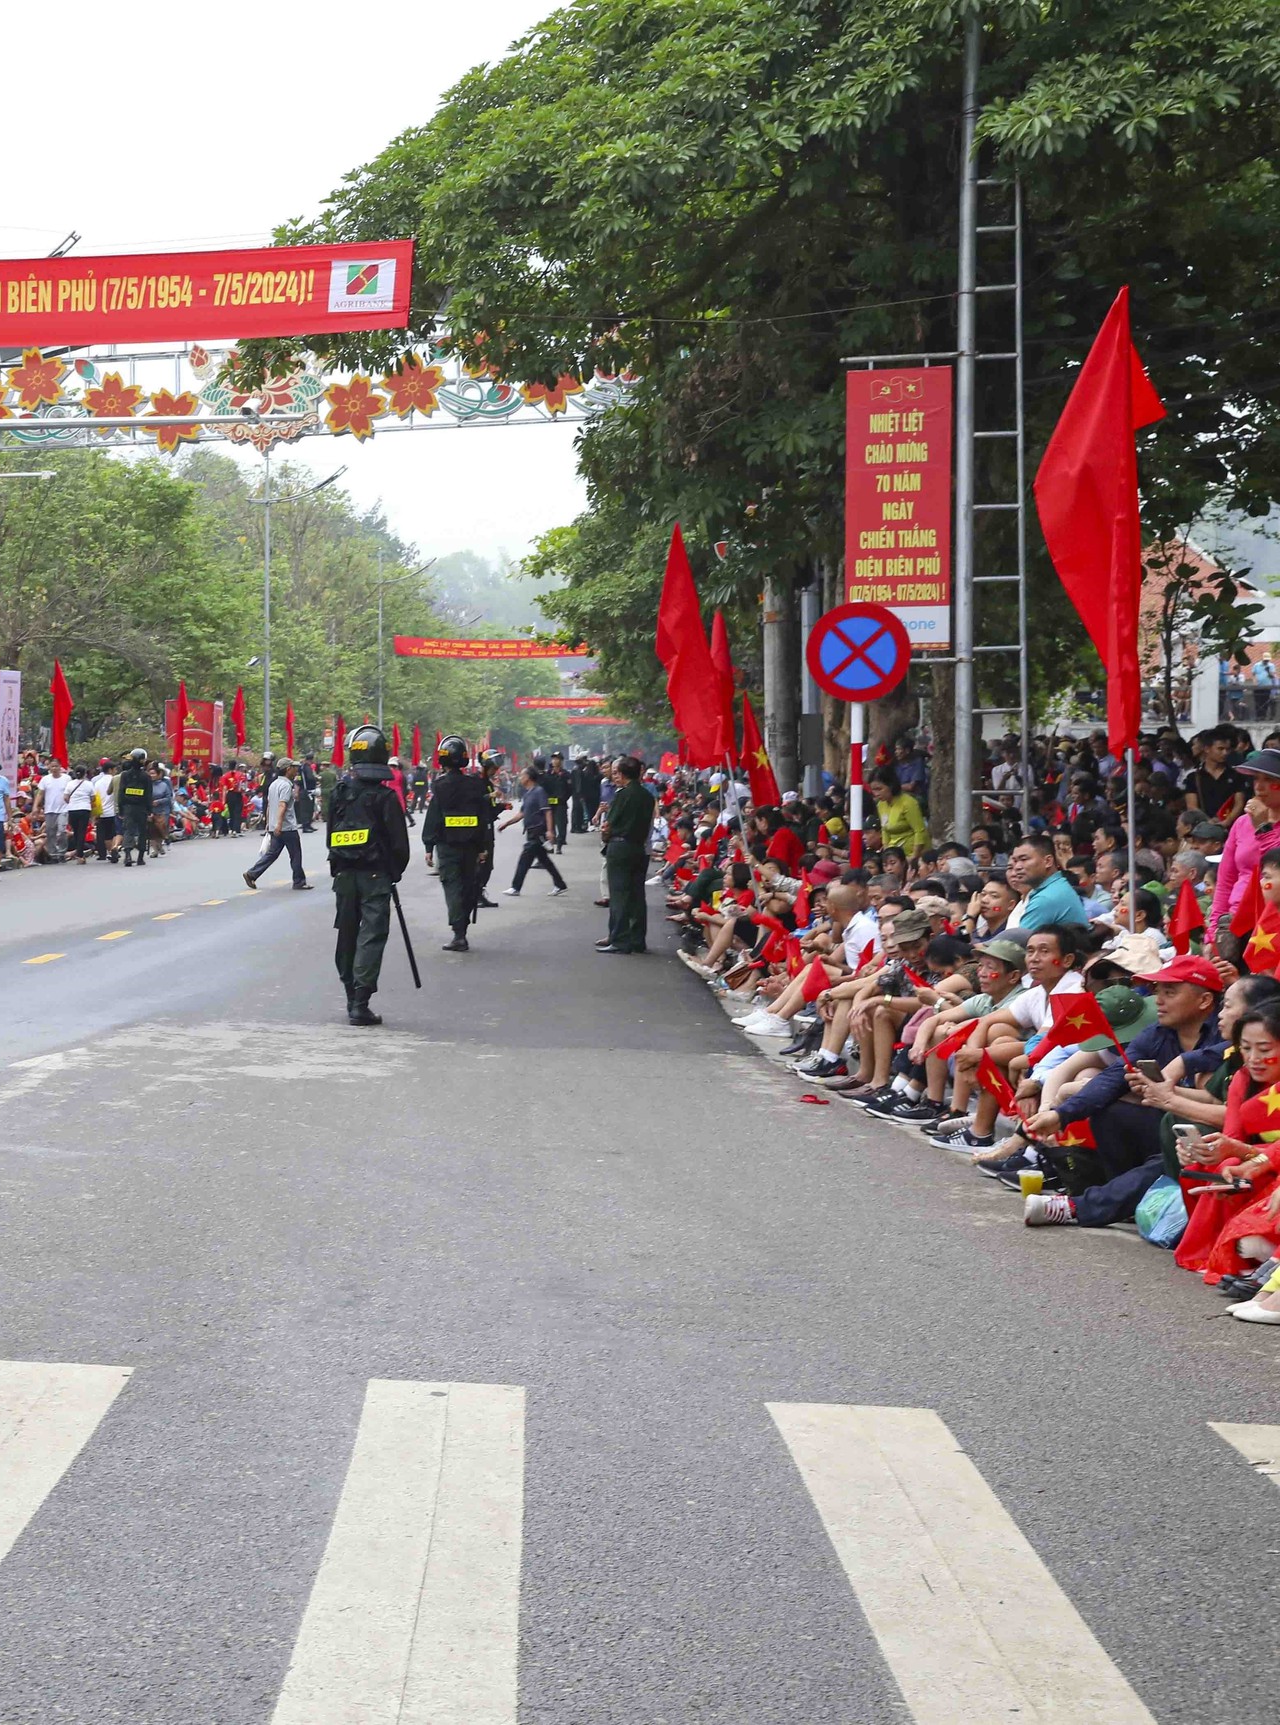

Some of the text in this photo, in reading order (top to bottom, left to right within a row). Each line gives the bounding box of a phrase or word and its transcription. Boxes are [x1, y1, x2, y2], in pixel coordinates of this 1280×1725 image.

[7, 273, 52, 313] BIÊN
[57, 270, 97, 312] PHỦ
[101, 275, 193, 314] (7/5/1954
[333, 299, 388, 308] AGRIBANK
[869, 408, 925, 437] NHIỆT LIỆT
[865, 439, 928, 464] CHÀO MỪNG
[875, 469, 921, 493] 70 NĂM
[882, 498, 915, 520] NGÀY
[859, 523, 937, 549] CHIẾN THẮNG
[855, 551, 941, 581] ĐIỆN BIÊN PHỦ
